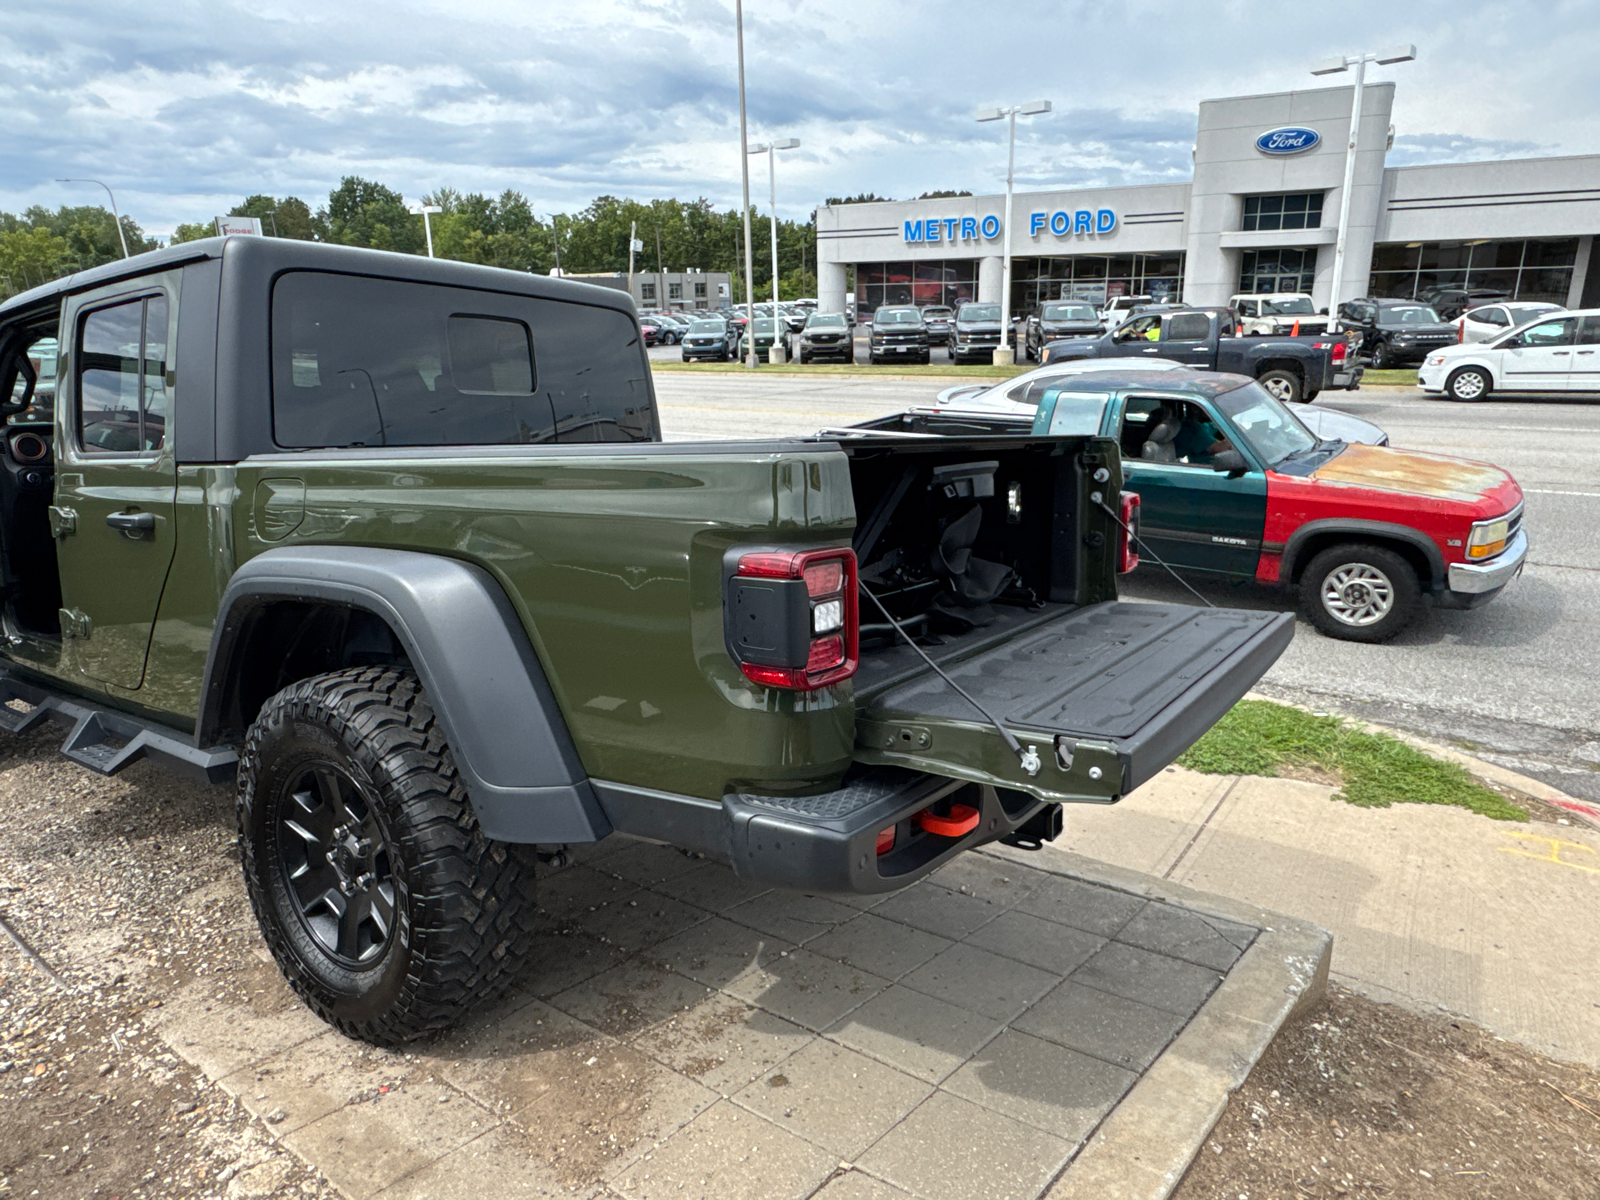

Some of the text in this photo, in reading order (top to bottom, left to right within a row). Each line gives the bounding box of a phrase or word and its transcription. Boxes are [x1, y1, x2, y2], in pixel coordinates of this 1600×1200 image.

[1268, 132, 1307, 148] Ford
[904, 209, 1117, 243] METRO FORD
[1211, 536, 1247, 546] DAKOTA
